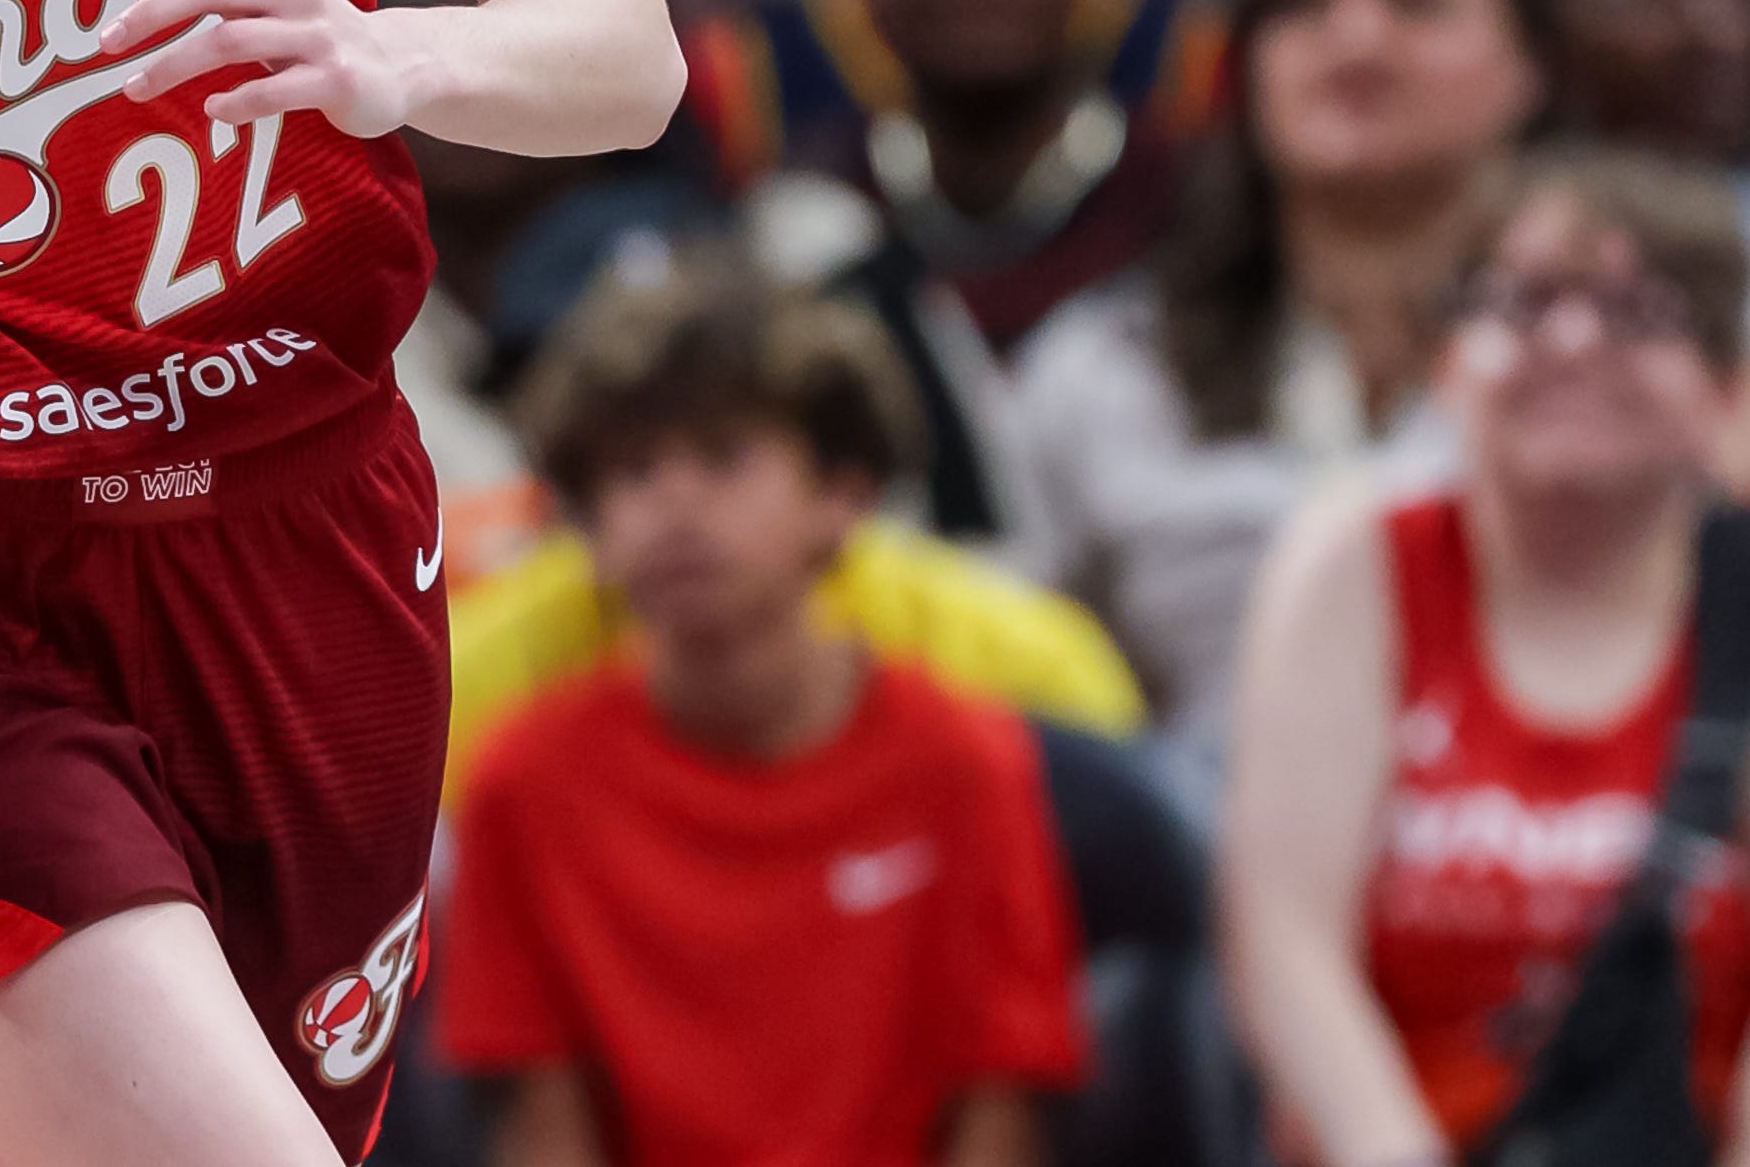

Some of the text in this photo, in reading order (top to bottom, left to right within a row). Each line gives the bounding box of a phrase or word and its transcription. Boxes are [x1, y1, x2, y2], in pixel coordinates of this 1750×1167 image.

[102, 82, 307, 331] 22
[0, 328, 318, 442] saesforce
[82, 467, 213, 504] TO WIN
